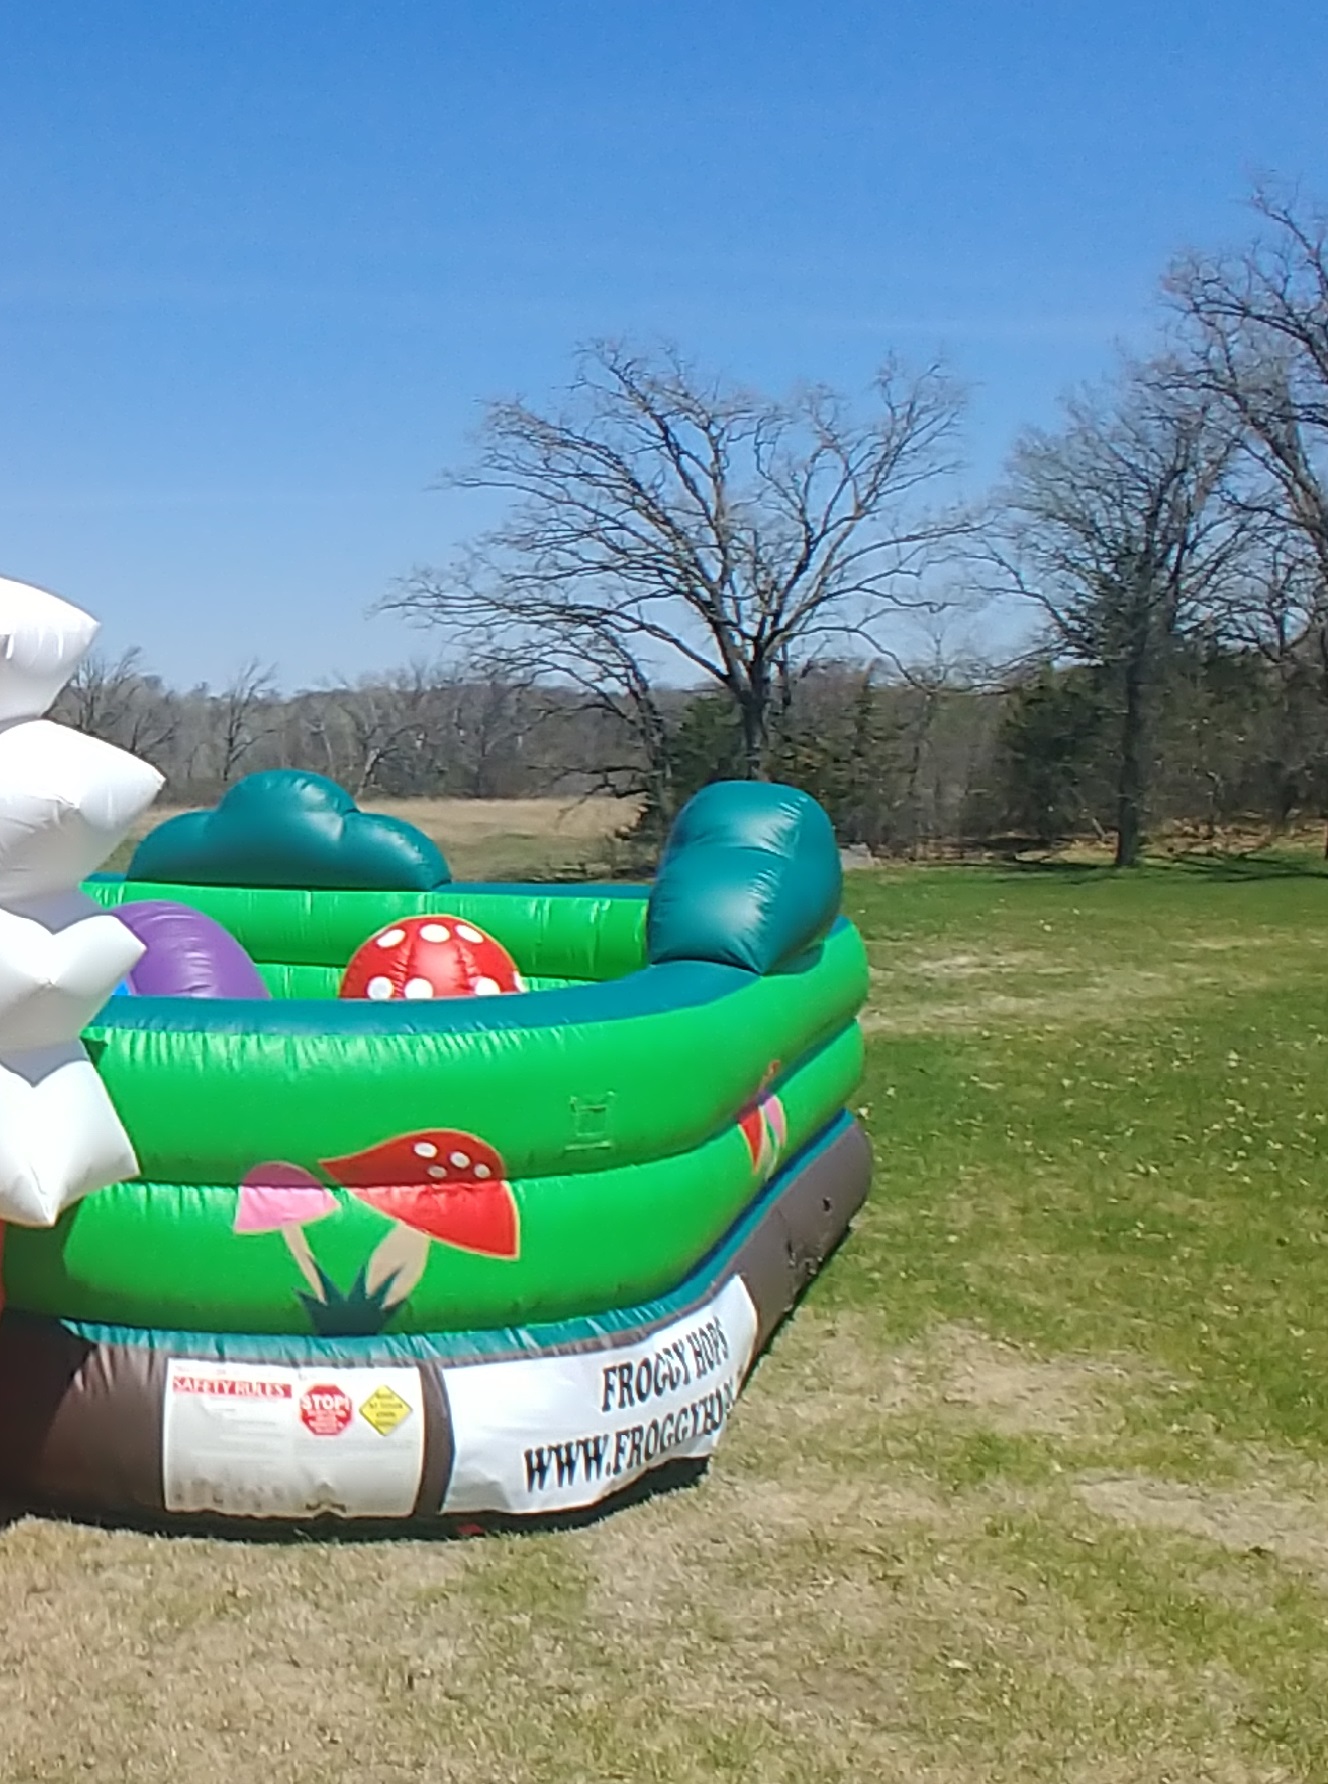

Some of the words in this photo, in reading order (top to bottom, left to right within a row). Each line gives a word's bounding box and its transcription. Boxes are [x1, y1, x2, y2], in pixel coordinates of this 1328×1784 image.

[173, 1376, 233, 1395] SAFETY
[235, 1381, 286, 1398] RULES
[602, 1338, 691, 1412] FROGGY
